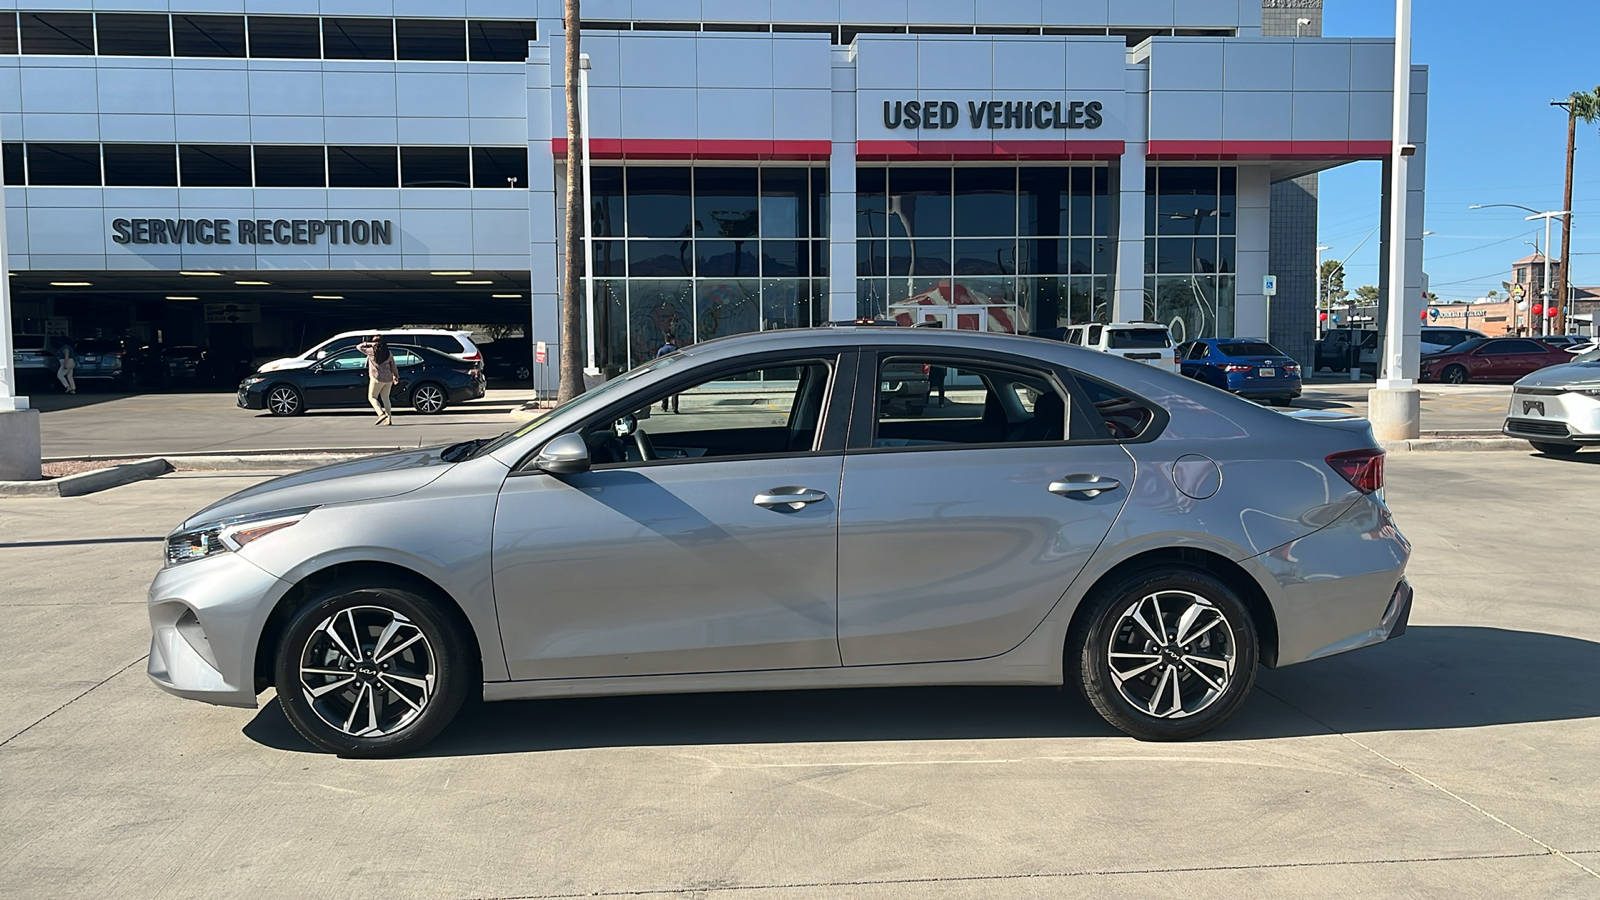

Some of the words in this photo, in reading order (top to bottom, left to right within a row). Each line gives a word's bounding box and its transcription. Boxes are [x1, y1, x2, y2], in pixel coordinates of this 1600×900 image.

[883, 101, 959, 129] USED
[968, 101, 1103, 129] VEHICLES
[112, 218, 232, 245] SERVICE
[238, 219, 392, 246] RECEPTION
